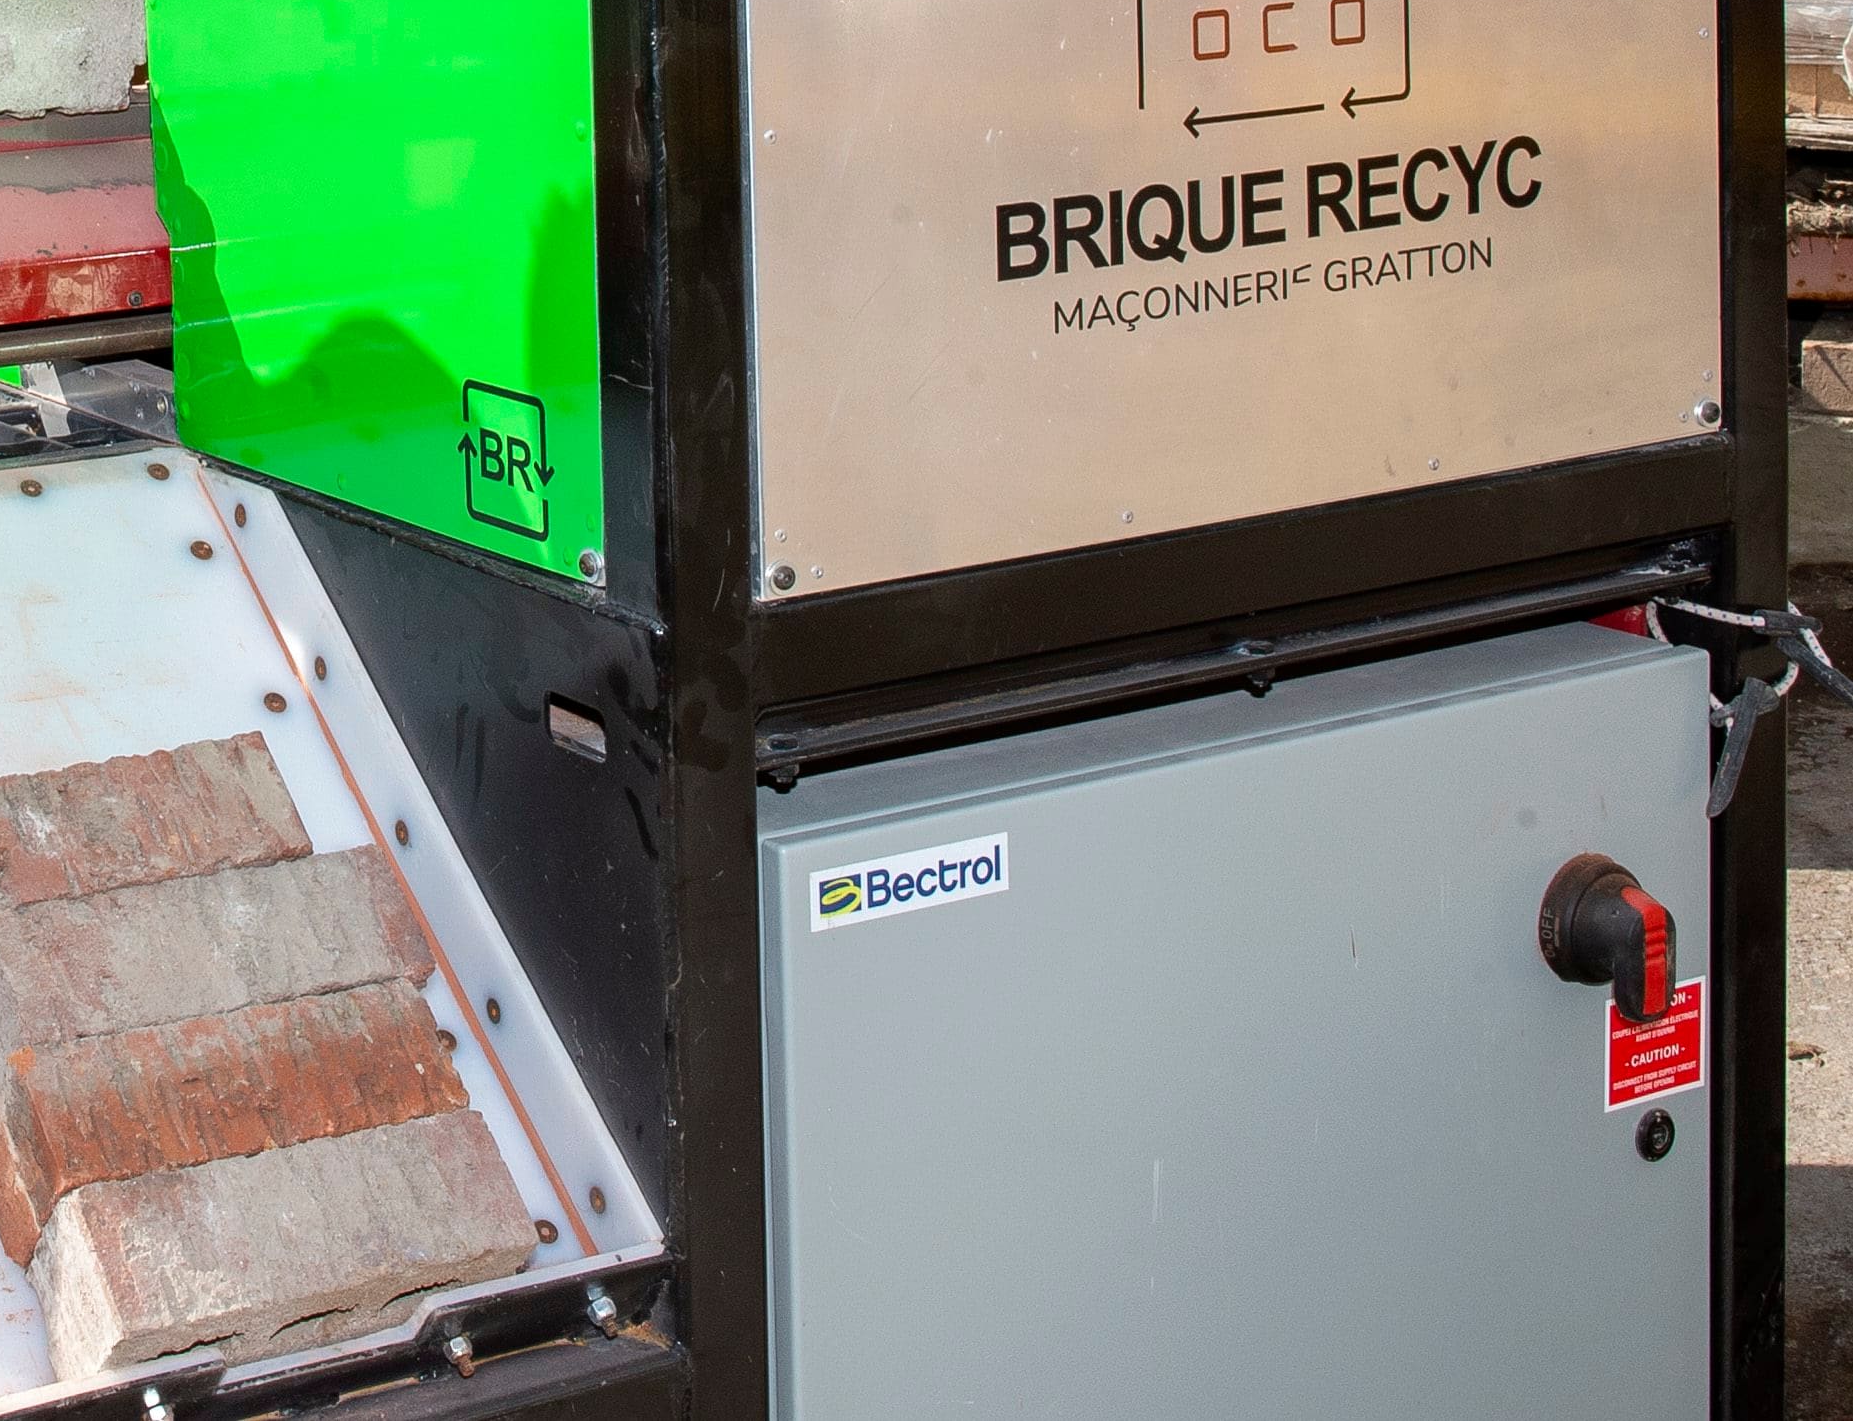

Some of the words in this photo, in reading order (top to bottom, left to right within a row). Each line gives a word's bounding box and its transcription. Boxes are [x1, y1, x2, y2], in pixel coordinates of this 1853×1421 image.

[995, 169, 1287, 282] BRIQUE
[1306, 135, 1543, 238] RECYC
[1323, 236, 1493, 293] GRATTON
[479, 427, 535, 493] BR
[867, 844, 1001, 909] Bectrol
[1541, 907, 1554, 939] OFF
[1631, 1043, 1680, 1067] CAUTION
